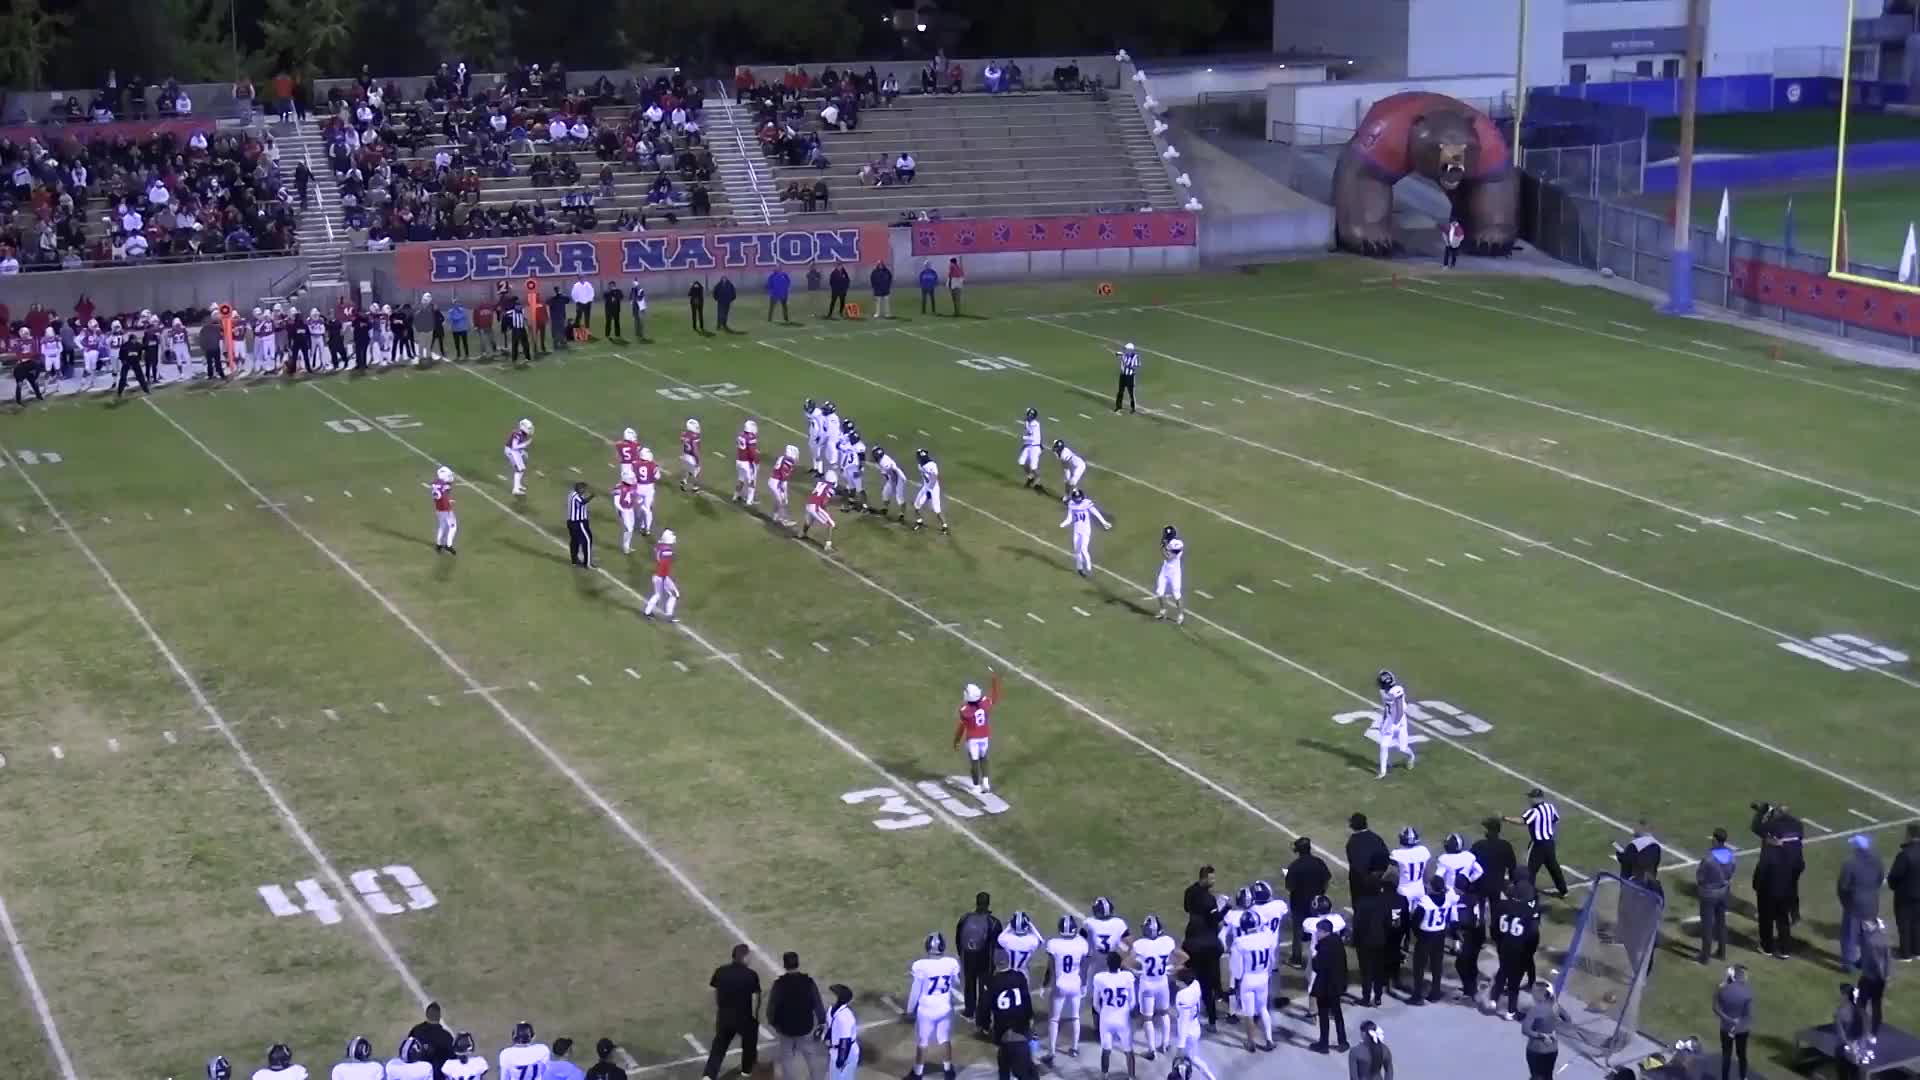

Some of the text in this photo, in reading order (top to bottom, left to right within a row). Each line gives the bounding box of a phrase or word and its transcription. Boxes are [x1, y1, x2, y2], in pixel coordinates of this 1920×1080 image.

[430, 229, 859, 282] BEAR NATION
[621, 447, 632, 461] 5
[638, 466, 648, 480] 9
[1776, 633, 1909, 671] 10
[1331, 700, 1494, 747] 20
[840, 776, 1010, 829] 30
[257, 865, 438, 925] 40
[1427, 908, 1446, 927] 13
[1499, 913, 1524, 936] 66
[1098, 935, 1110, 953] 3
[1010, 951, 1029, 968] 17
[1144, 955, 1168, 976] 23
[1251, 948, 1269, 971] 14
[928, 975, 951, 995] 73
[997, 987, 1021, 1010] 61
[1104, 987, 1127, 1007] 25
